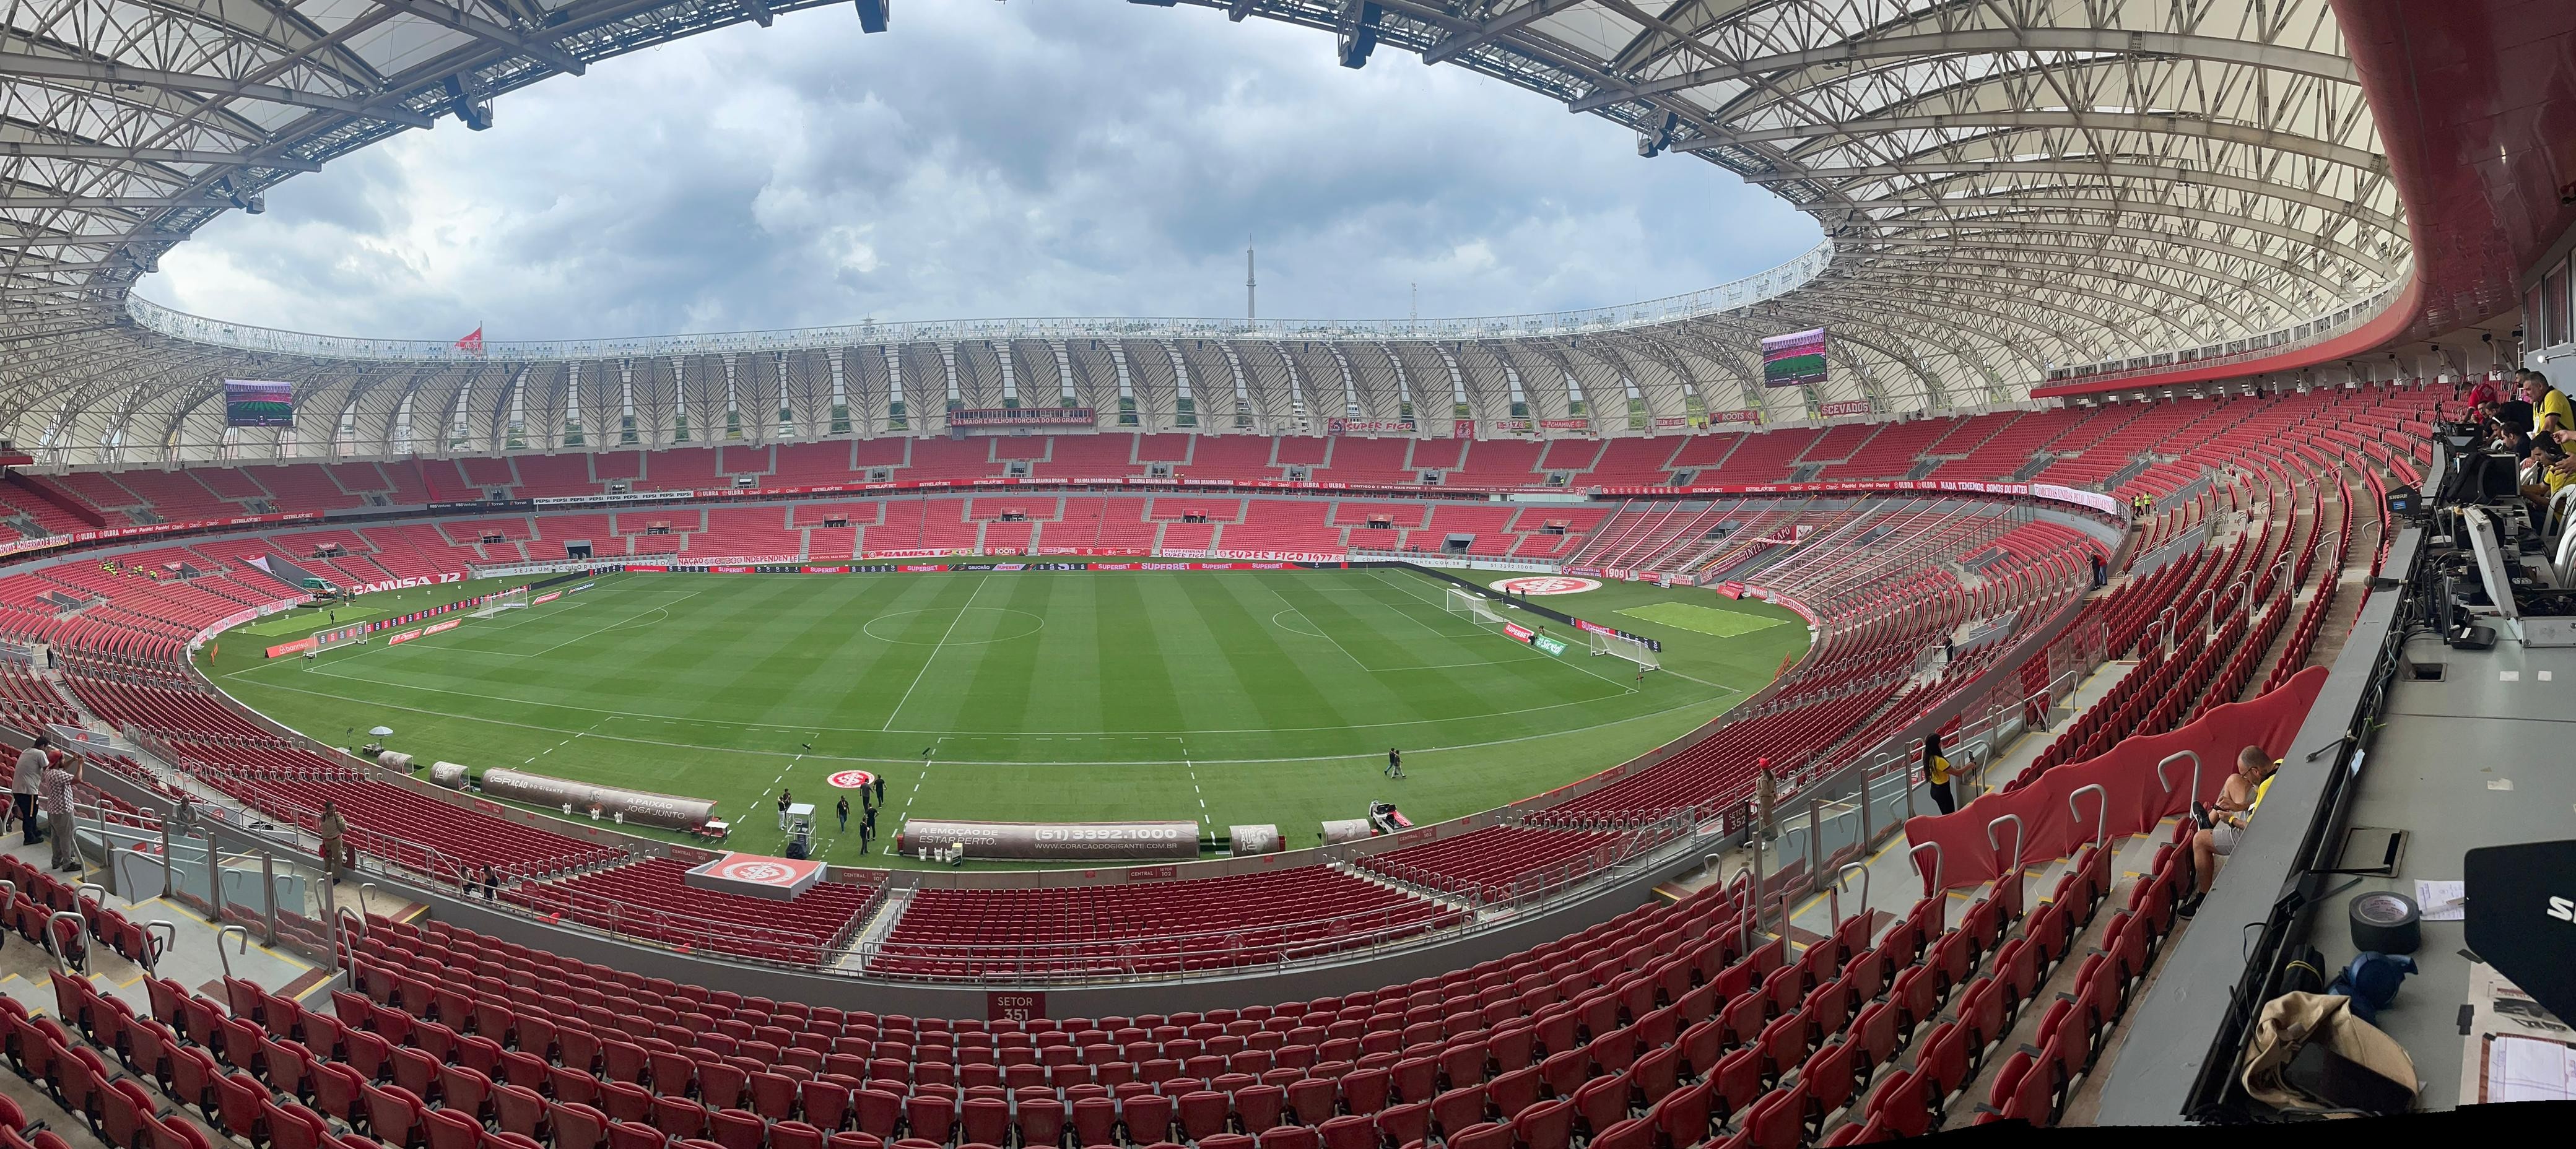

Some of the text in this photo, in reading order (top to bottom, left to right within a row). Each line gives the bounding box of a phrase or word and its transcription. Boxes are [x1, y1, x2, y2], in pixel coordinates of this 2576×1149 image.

[1829, 402, 1868, 414] CEVADOS
[1722, 412, 1744, 420] ROOTS
[1346, 422, 1382, 430] SUPER
[1941, 481, 2027, 494] NADA TEMEMOS, SOMOS DO INTER
[81, 532, 96, 540] ULBRA
[16, 539, 45, 550] AGUERRIDO
[1744, 542, 1766, 558] INTER
[1229, 550, 1332, 562] SUPER FICO 1977
[1141, 562, 1191, 570] SUPERBET
[1605, 568, 1624, 578] 1909
[353, 572, 461, 596] CAMISA 12
[1506, 624, 1531, 639] SUPERBET
[1544, 637, 1564, 654] Sicredi
[490, 776, 528, 789] CORAÇÃO
[539, 786, 564, 794] GIGANTE
[637, 797, 673, 809] PAIXÃO
[625, 805, 687, 820] JOGA JUNTO.
[1731, 815, 1746, 830] 352
[929, 827, 981, 837] EMOÇÃO
[1035, 828, 1177, 841] (51) 3392.1000
[1399, 833, 1418, 842] CENTRAL
[919, 836, 997, 846] ESTAR PERTO.
[1035, 842, 1177, 850] WWW.CORACAODOGIGANTE.COM.BR
[671, 848, 691, 857] CENTRAL
[2547, 896, 2576, 924] S
[998, 997, 1033, 1006] SETOR
[1004, 1008, 1029, 1020] 351
